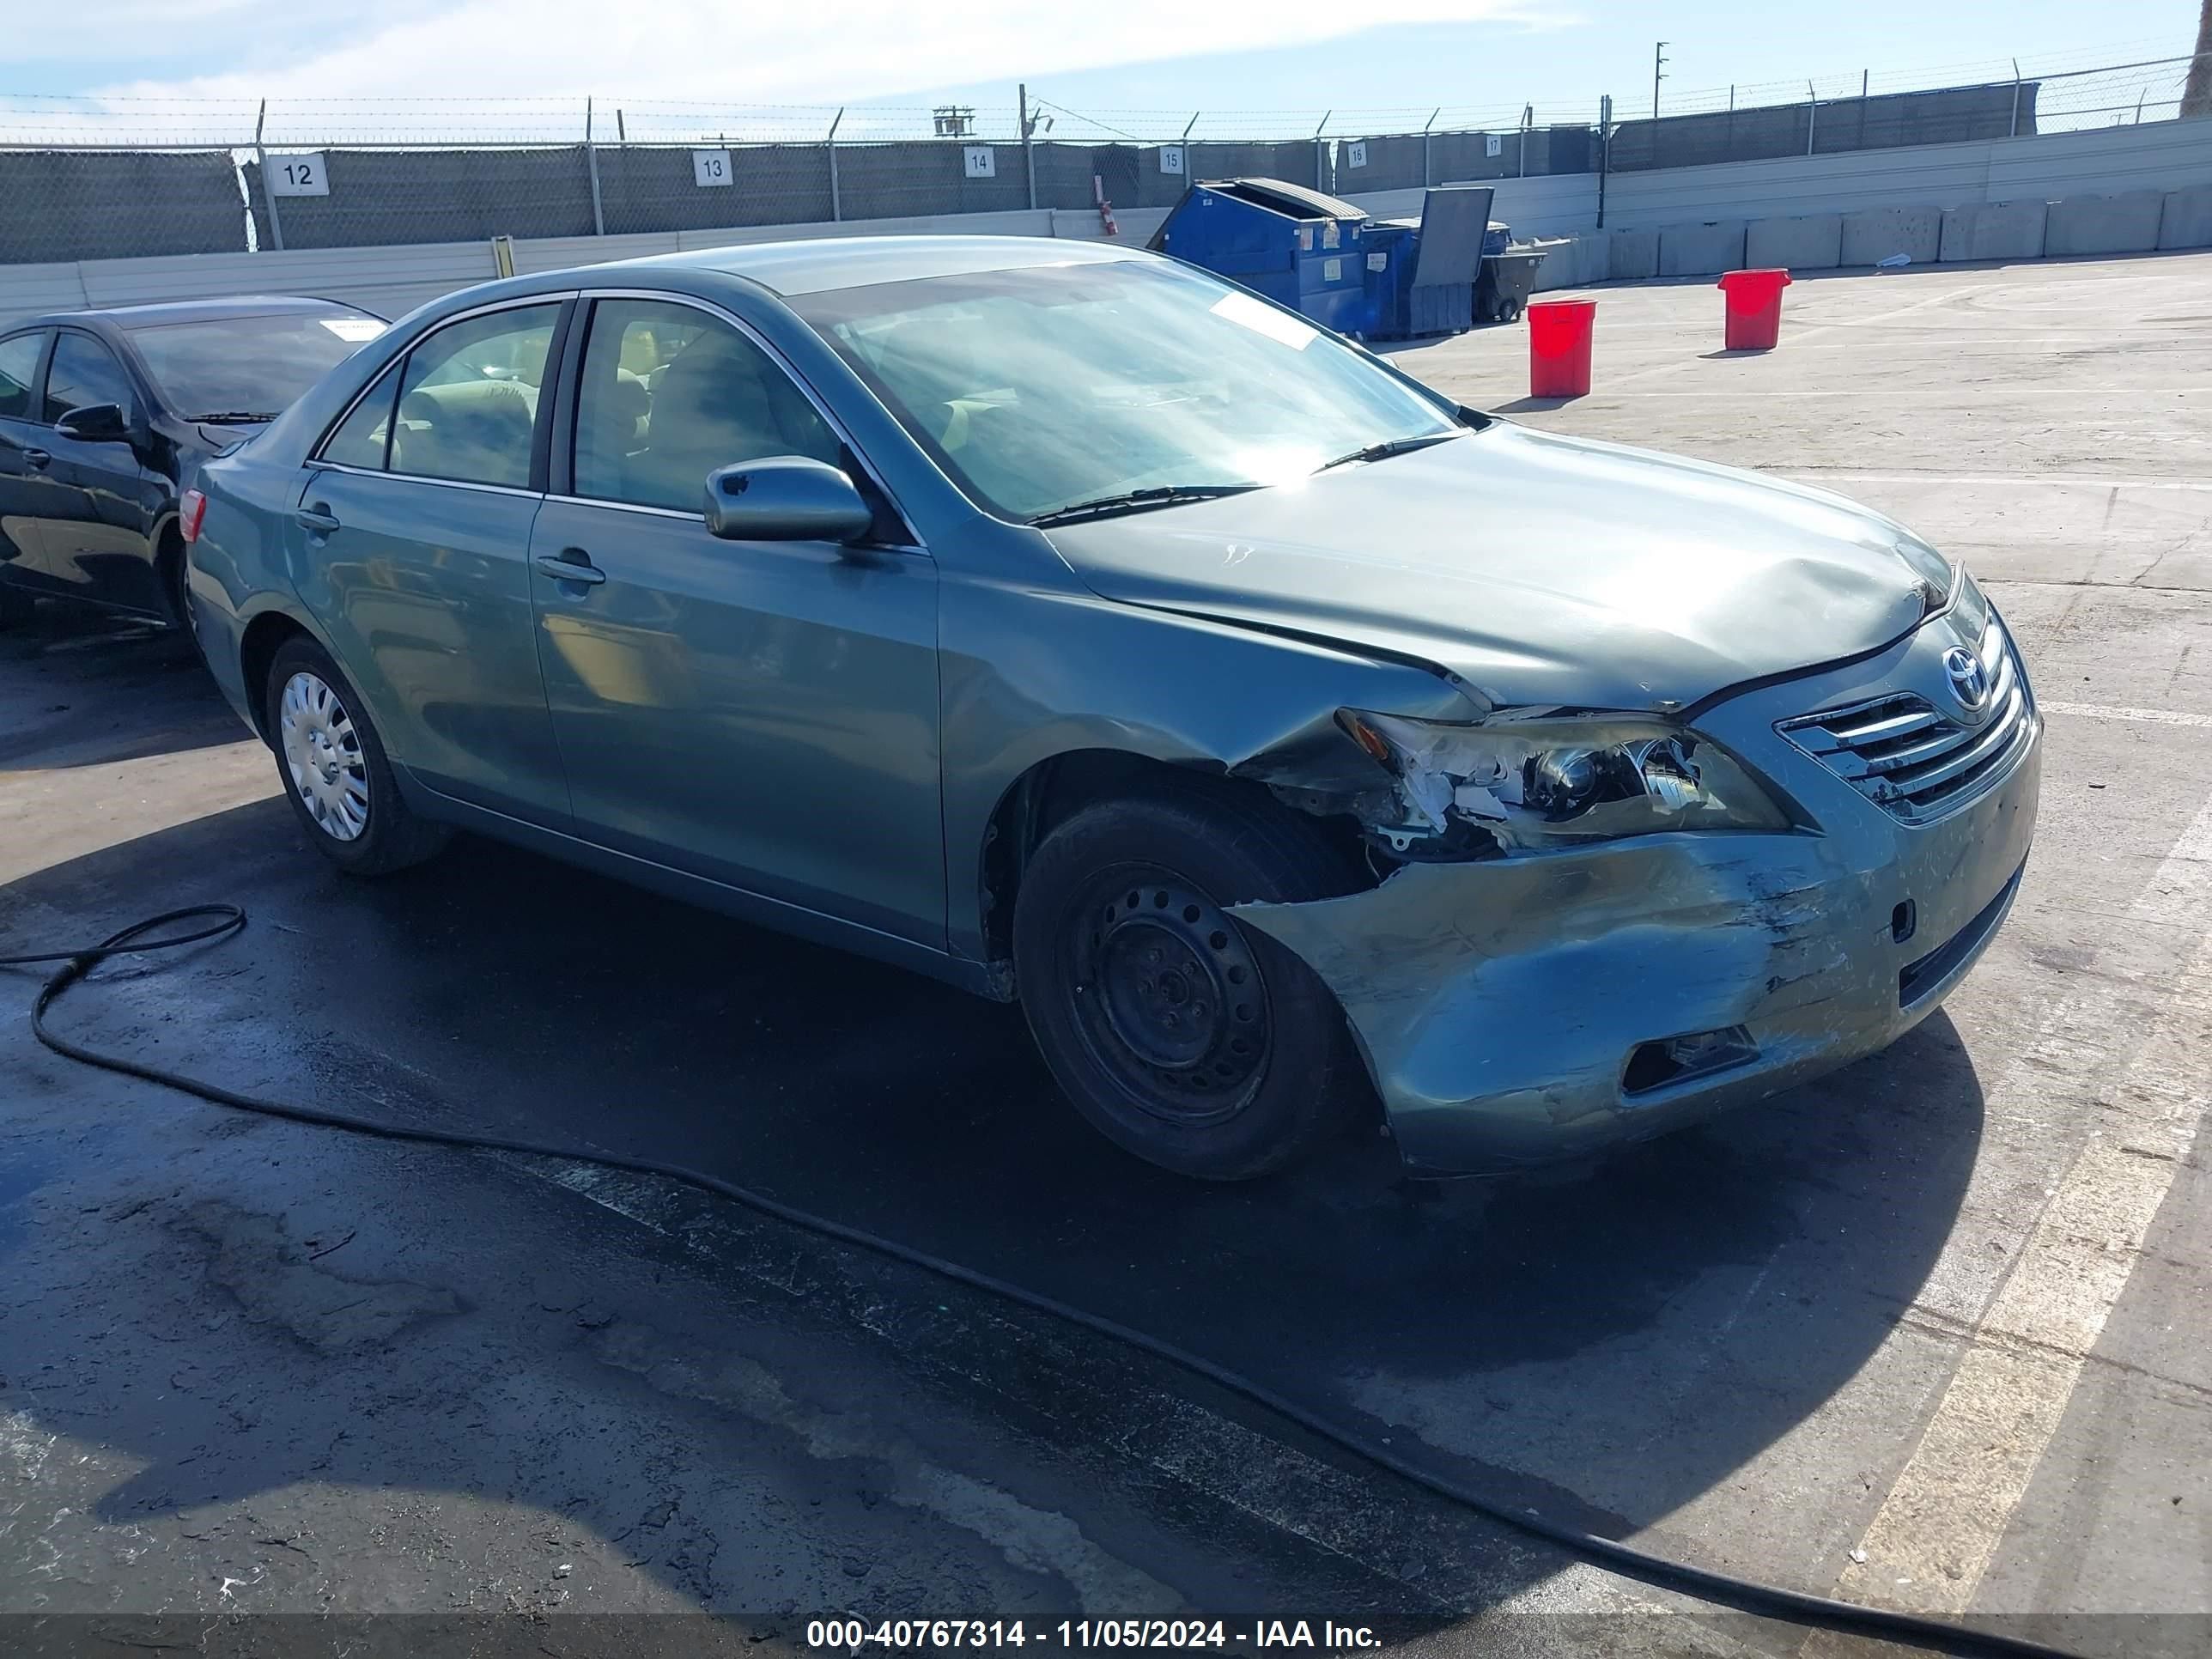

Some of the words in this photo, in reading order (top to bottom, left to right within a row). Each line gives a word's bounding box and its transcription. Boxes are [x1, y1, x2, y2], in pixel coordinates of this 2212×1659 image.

[1490, 140, 1498, 151] 17
[1166, 154, 1177, 167] 15
[1352, 149, 1362, 161] 16
[704, 160, 723, 177] 13
[972, 155, 987, 169] 14
[284, 165, 313, 185] 12
